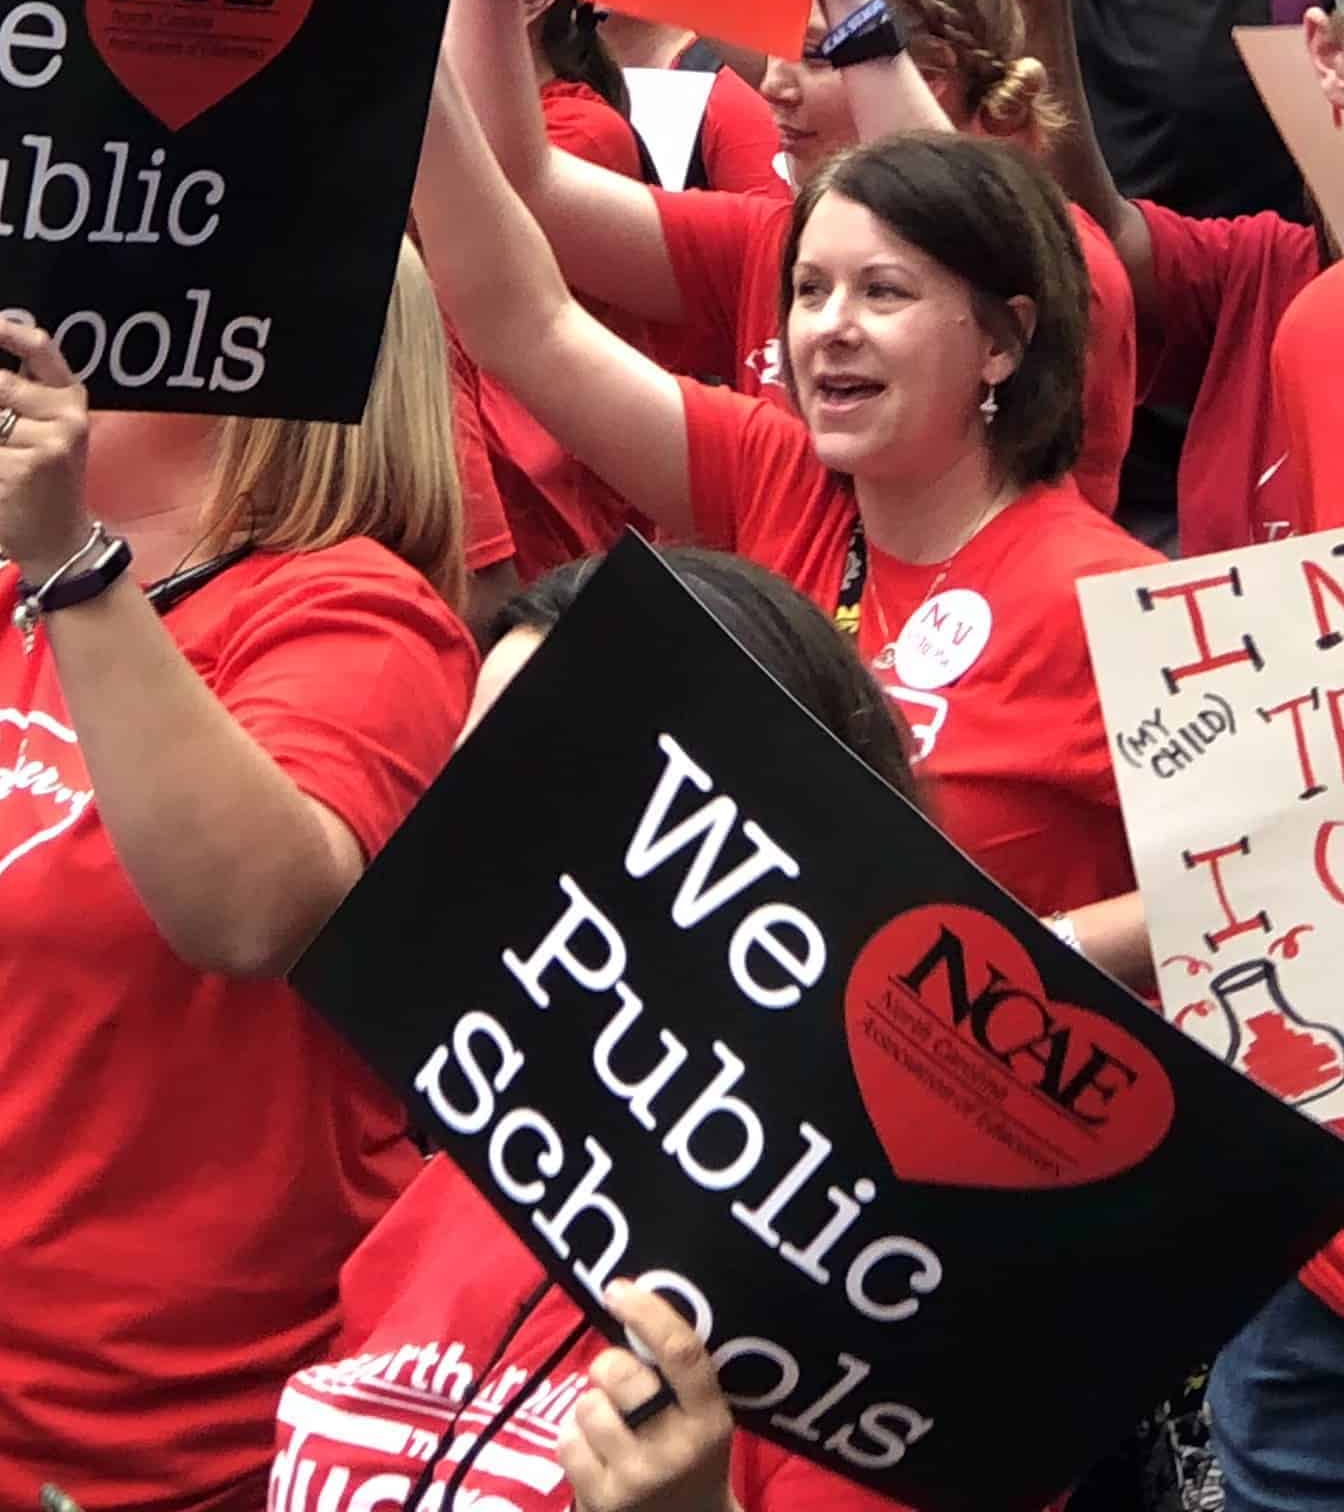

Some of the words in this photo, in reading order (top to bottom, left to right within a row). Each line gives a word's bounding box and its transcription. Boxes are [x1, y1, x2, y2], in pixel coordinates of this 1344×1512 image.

[1137, 568, 1266, 694] I
[621, 733, 828, 1010] We
[1183, 835, 1272, 953] I
[501, 872, 943, 1322] Public
[896, 923, 1138, 1126] NCAE
